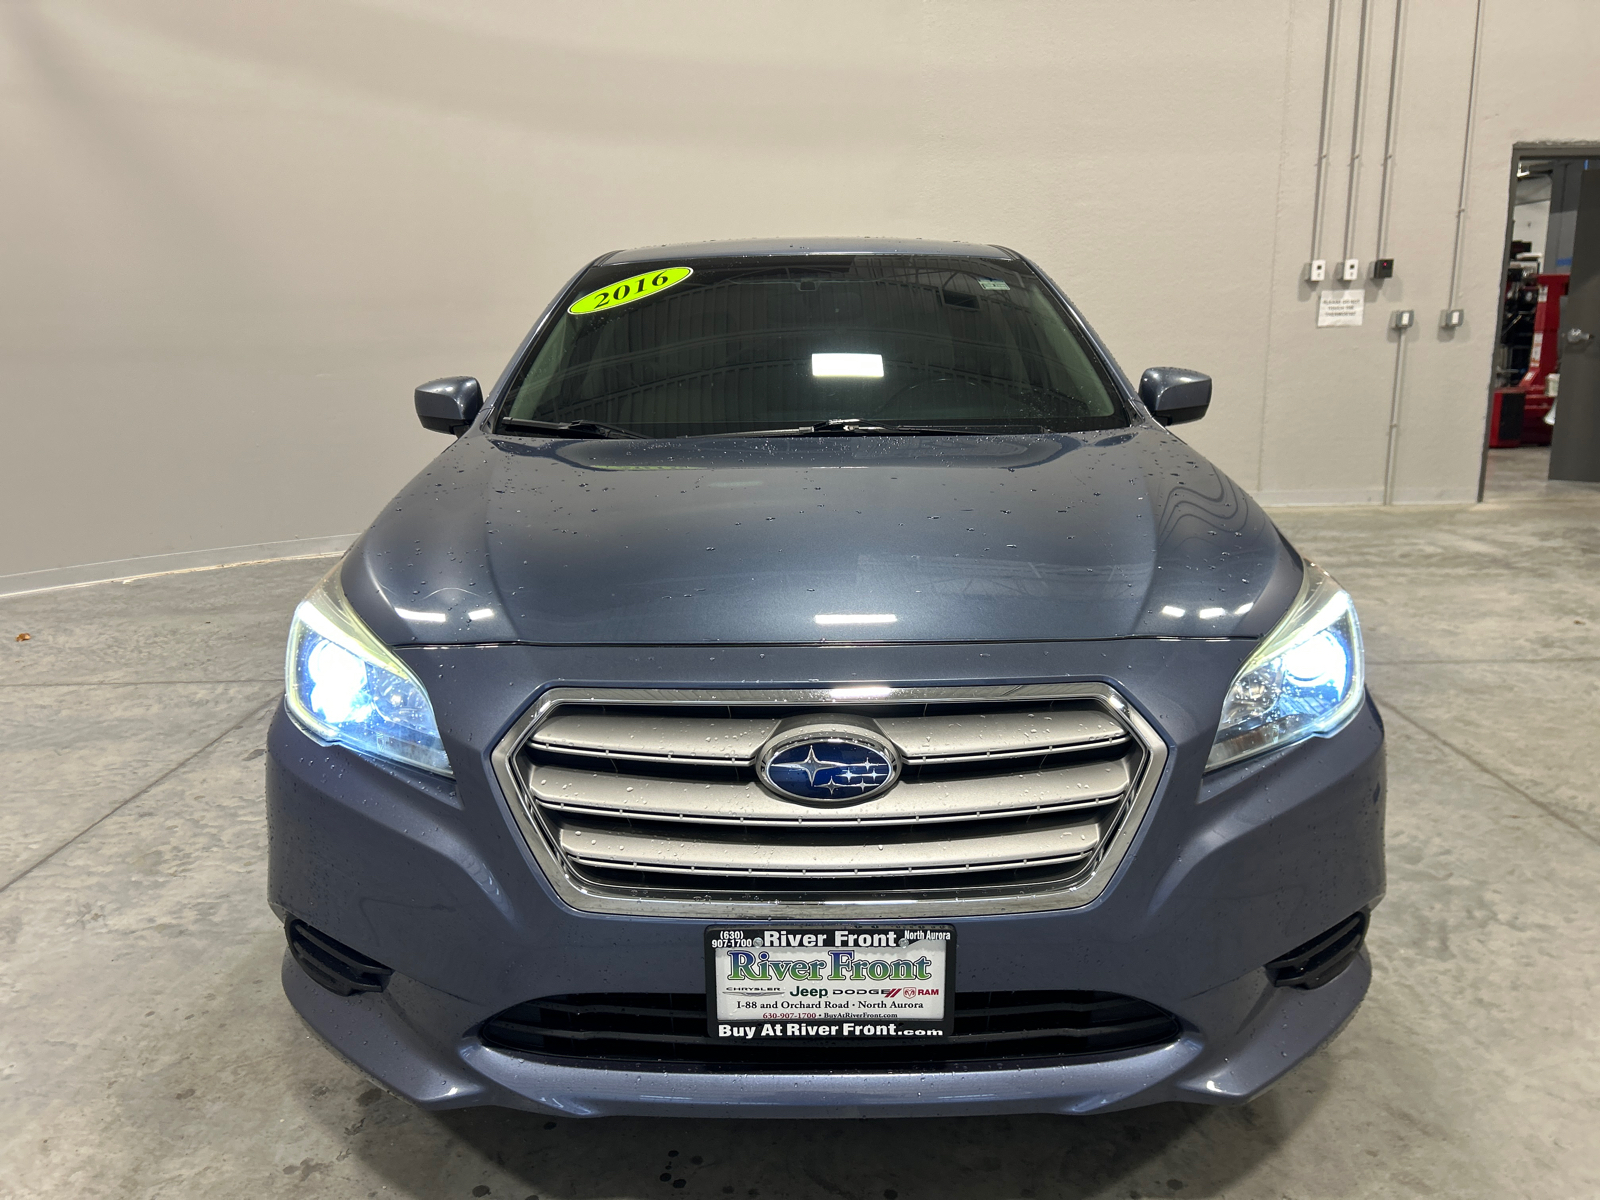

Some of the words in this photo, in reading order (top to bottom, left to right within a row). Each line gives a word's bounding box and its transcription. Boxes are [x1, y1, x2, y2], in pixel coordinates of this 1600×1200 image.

[594, 270, 668, 309] 2016
[720, 931, 744, 940] (630)
[764, 930, 827, 947] River
[834, 930, 897, 947] Front
[904, 930, 925, 940] North
[926, 930, 951, 940] Aurora
[711, 939, 752, 948] 907-1700
[727, 949, 827, 981] River
[827, 949, 932, 981] Front
[789, 986, 828, 998] Jeep
[736, 1001, 757, 1009] I-88
[760, 1001, 778, 1009] and
[781, 1001, 821, 1009] Orchard
[824, 1001, 850, 1009] Road
[857, 1001, 887, 1009] North
[889, 1001, 924, 1009] Aurora
[718, 1024, 756, 1039] Buy
[761, 1024, 783, 1036] At
[786, 1023, 839, 1036] River
